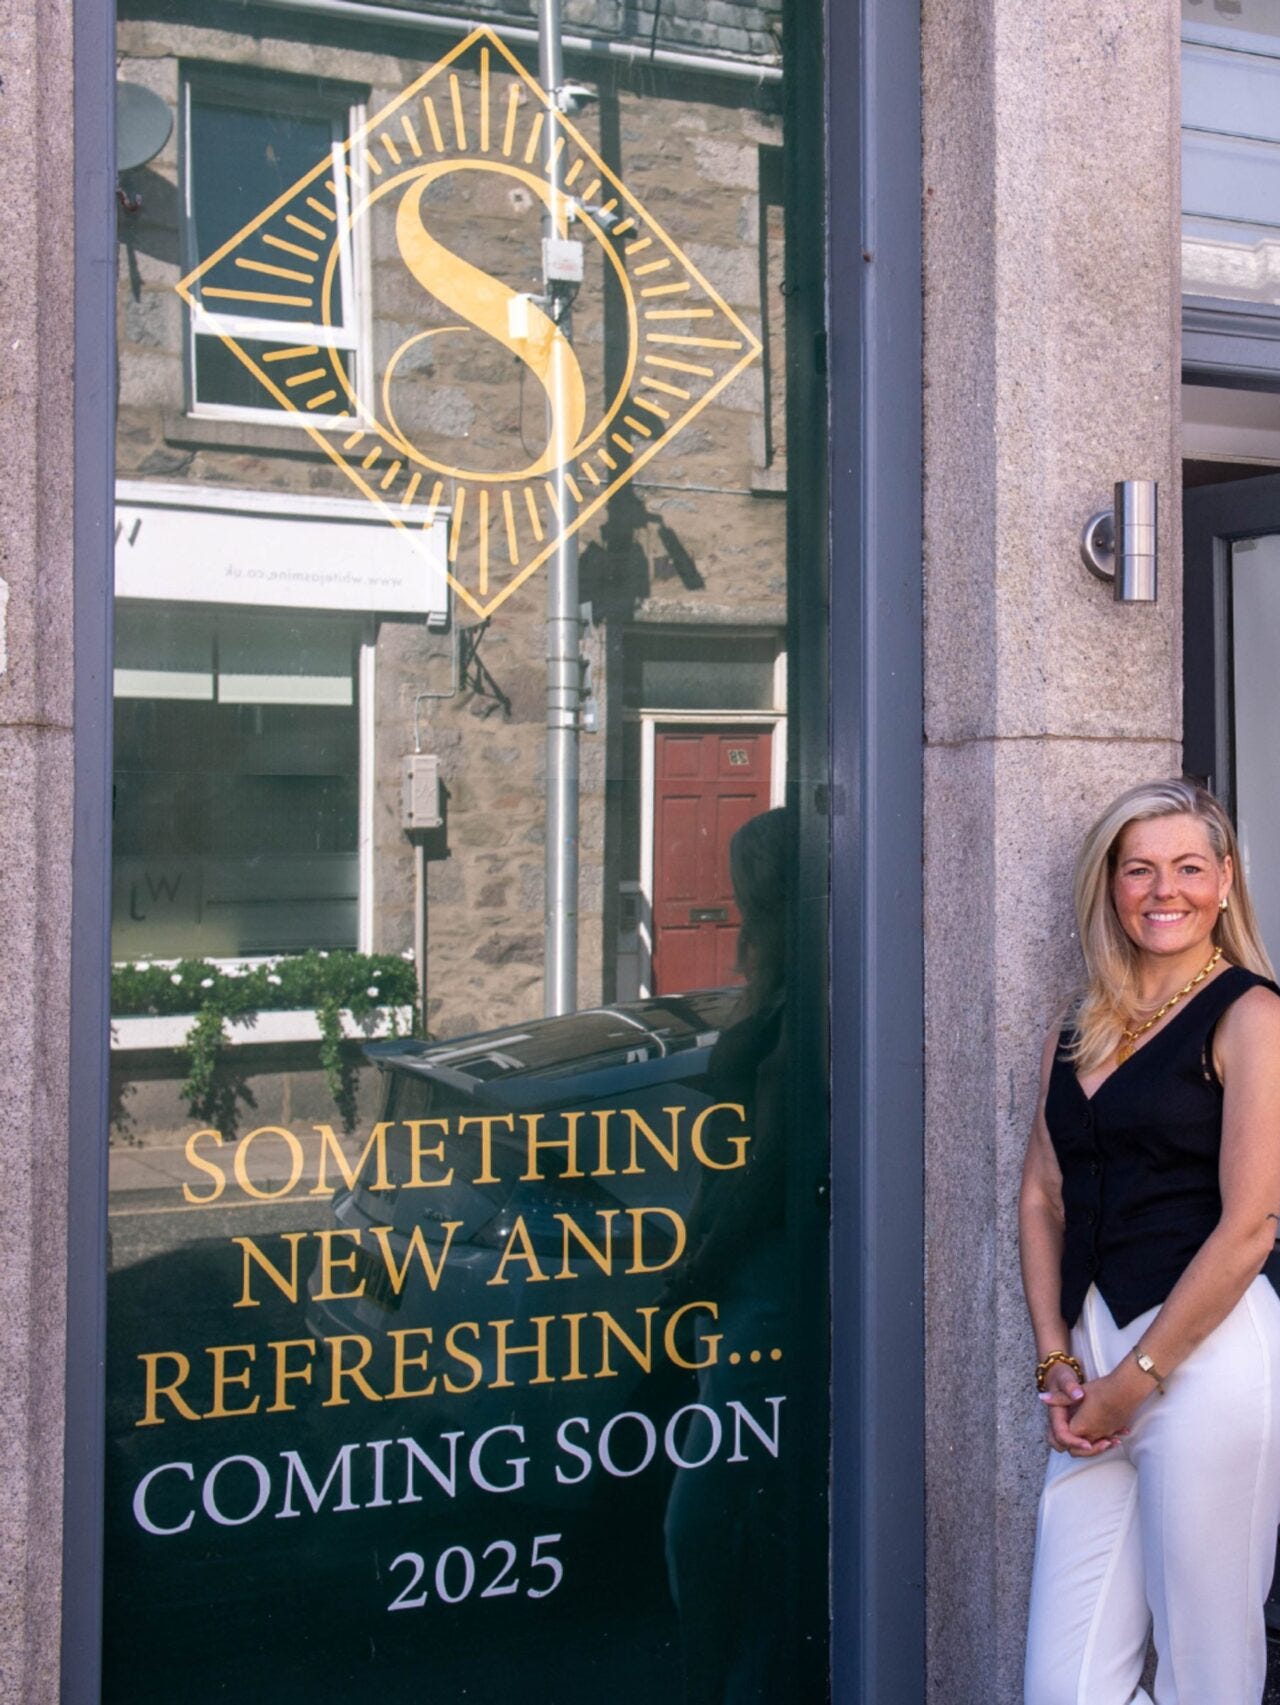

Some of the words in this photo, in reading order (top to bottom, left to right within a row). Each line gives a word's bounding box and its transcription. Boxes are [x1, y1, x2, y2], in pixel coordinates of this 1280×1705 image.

[382, 159, 587, 482] S
[181, 1102, 751, 1206] SOMETHING
[231, 1221, 463, 1308] NEW
[486, 1206, 687, 1286] AND
[134, 1302, 783, 1427] REFRESHING...
[132, 1425, 530, 1536] COMING
[554, 1396, 787, 1485] SOON
[387, 1533, 564, 1612] 2025
